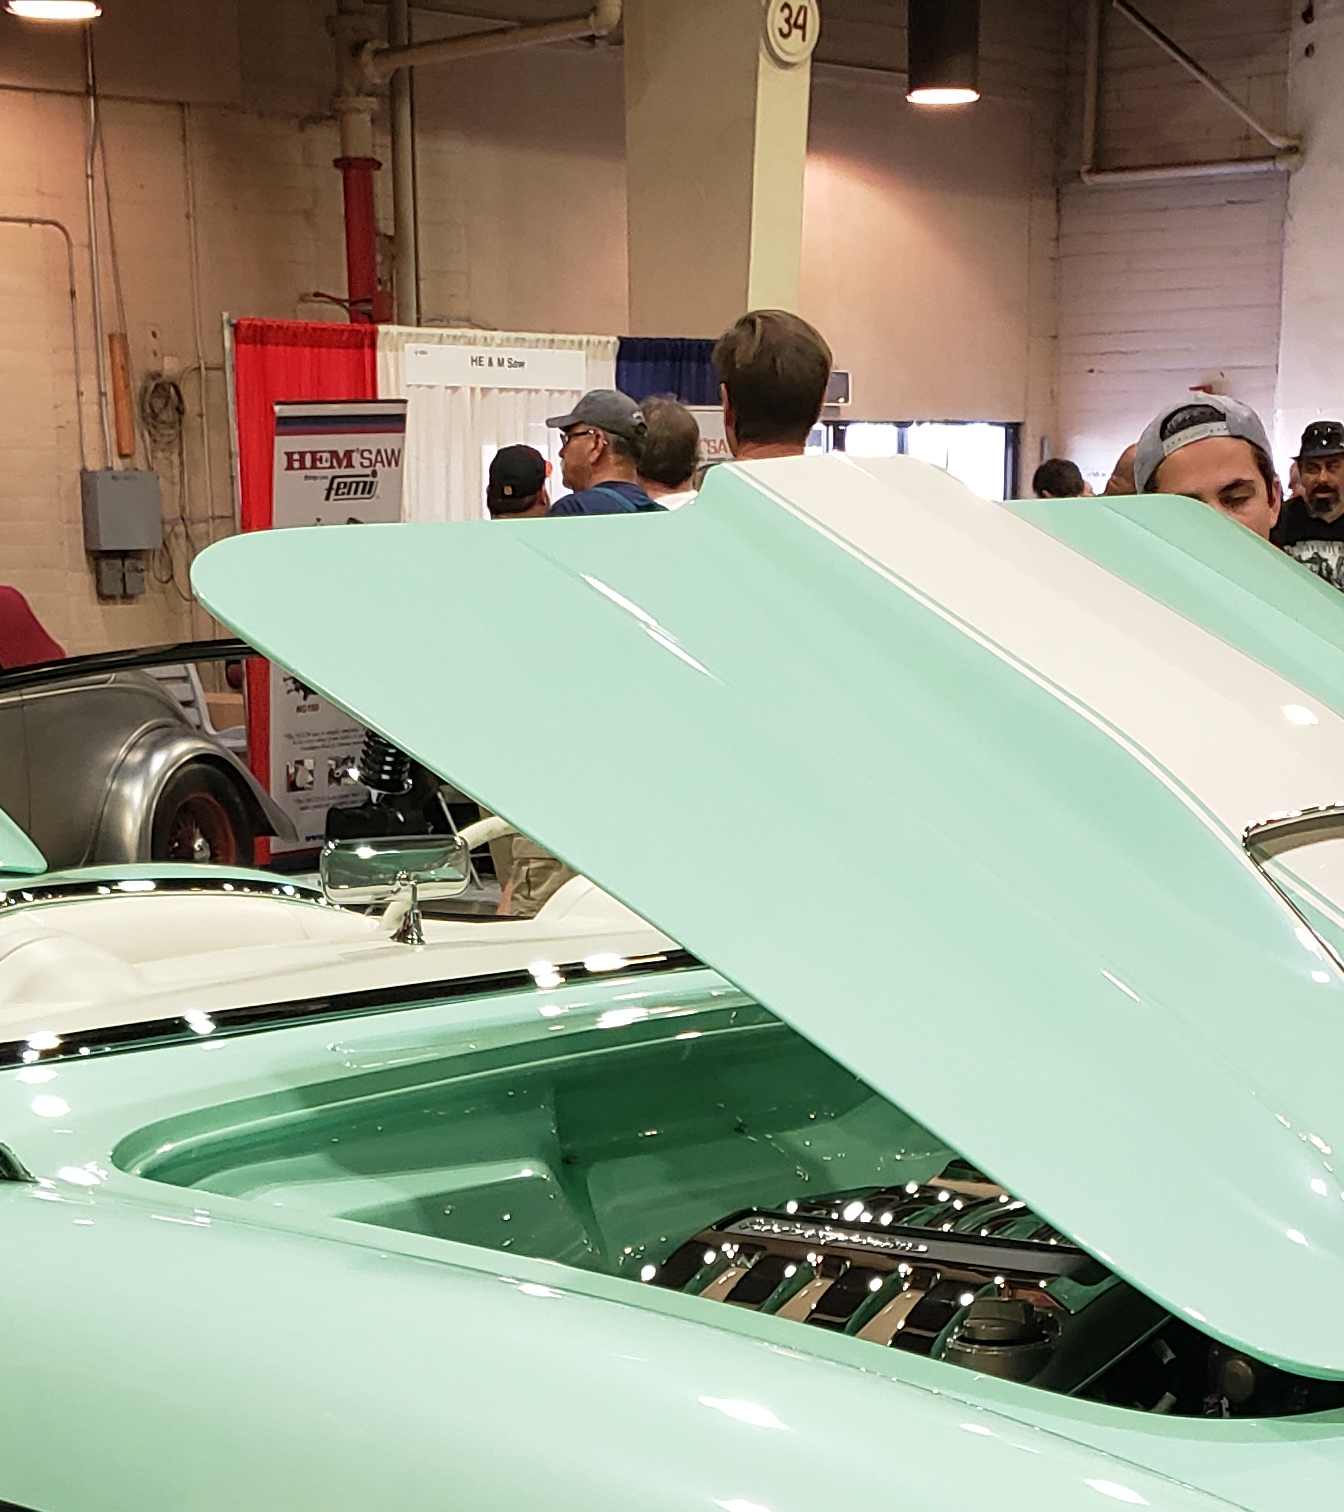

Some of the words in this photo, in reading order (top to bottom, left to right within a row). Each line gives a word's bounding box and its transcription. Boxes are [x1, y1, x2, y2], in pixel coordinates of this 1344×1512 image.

[777, 1, 808, 43] 34
[359, 448, 402, 469] SAW
[324, 469, 378, 501] femi
